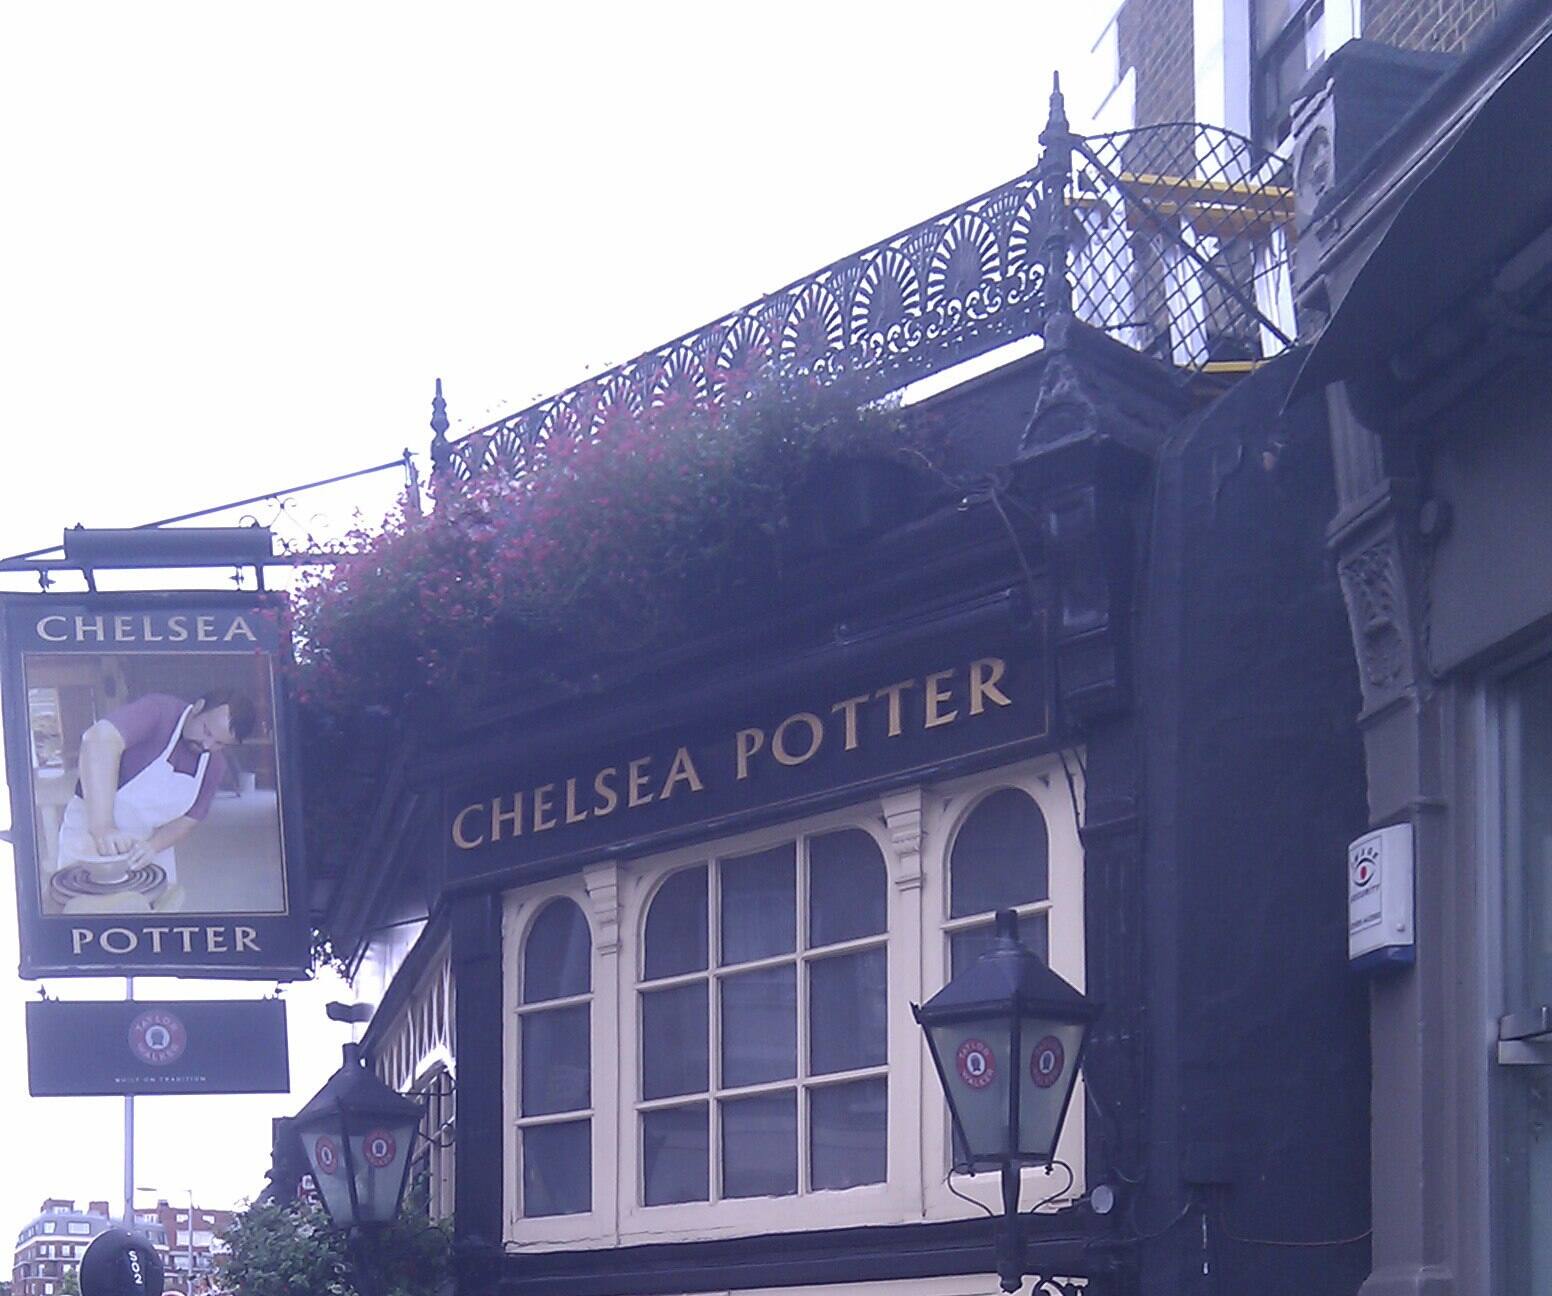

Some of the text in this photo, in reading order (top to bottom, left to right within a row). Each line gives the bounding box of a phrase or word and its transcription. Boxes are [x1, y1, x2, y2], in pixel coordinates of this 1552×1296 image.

[36, 615, 257, 641] CHELSEA
[452, 656, 1012, 851] CHELSEA POTTER
[71, 927, 261, 954] POTTER
